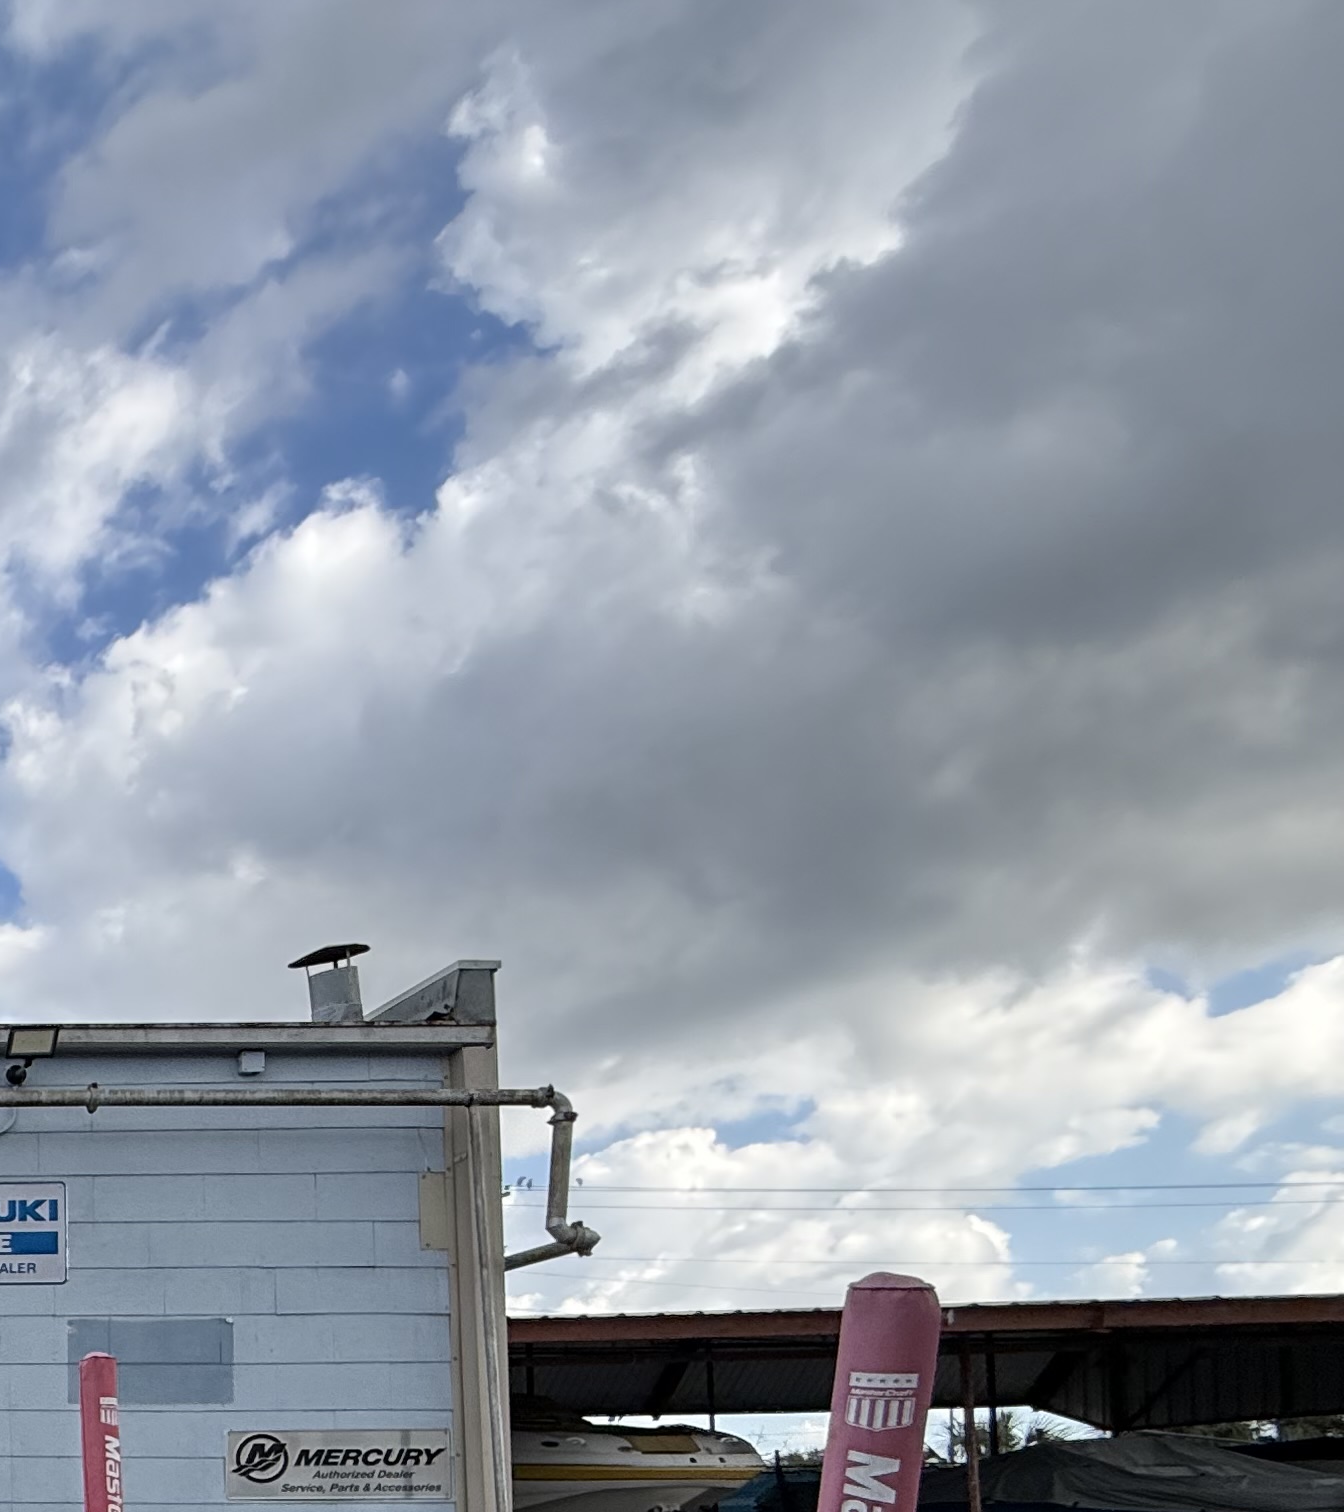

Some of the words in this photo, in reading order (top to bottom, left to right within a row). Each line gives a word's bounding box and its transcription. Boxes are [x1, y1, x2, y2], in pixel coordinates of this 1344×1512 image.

[294, 1448, 448, 1467] MERCURY
[312, 1470, 374, 1480] Authorized
[377, 1470, 415, 1479] Dealer
[281, 1483, 326, 1494] Service,
[329, 1483, 360, 1493] Parts
[363, 1483, 371, 1492] &
[373, 1483, 442, 1492] Accessories
